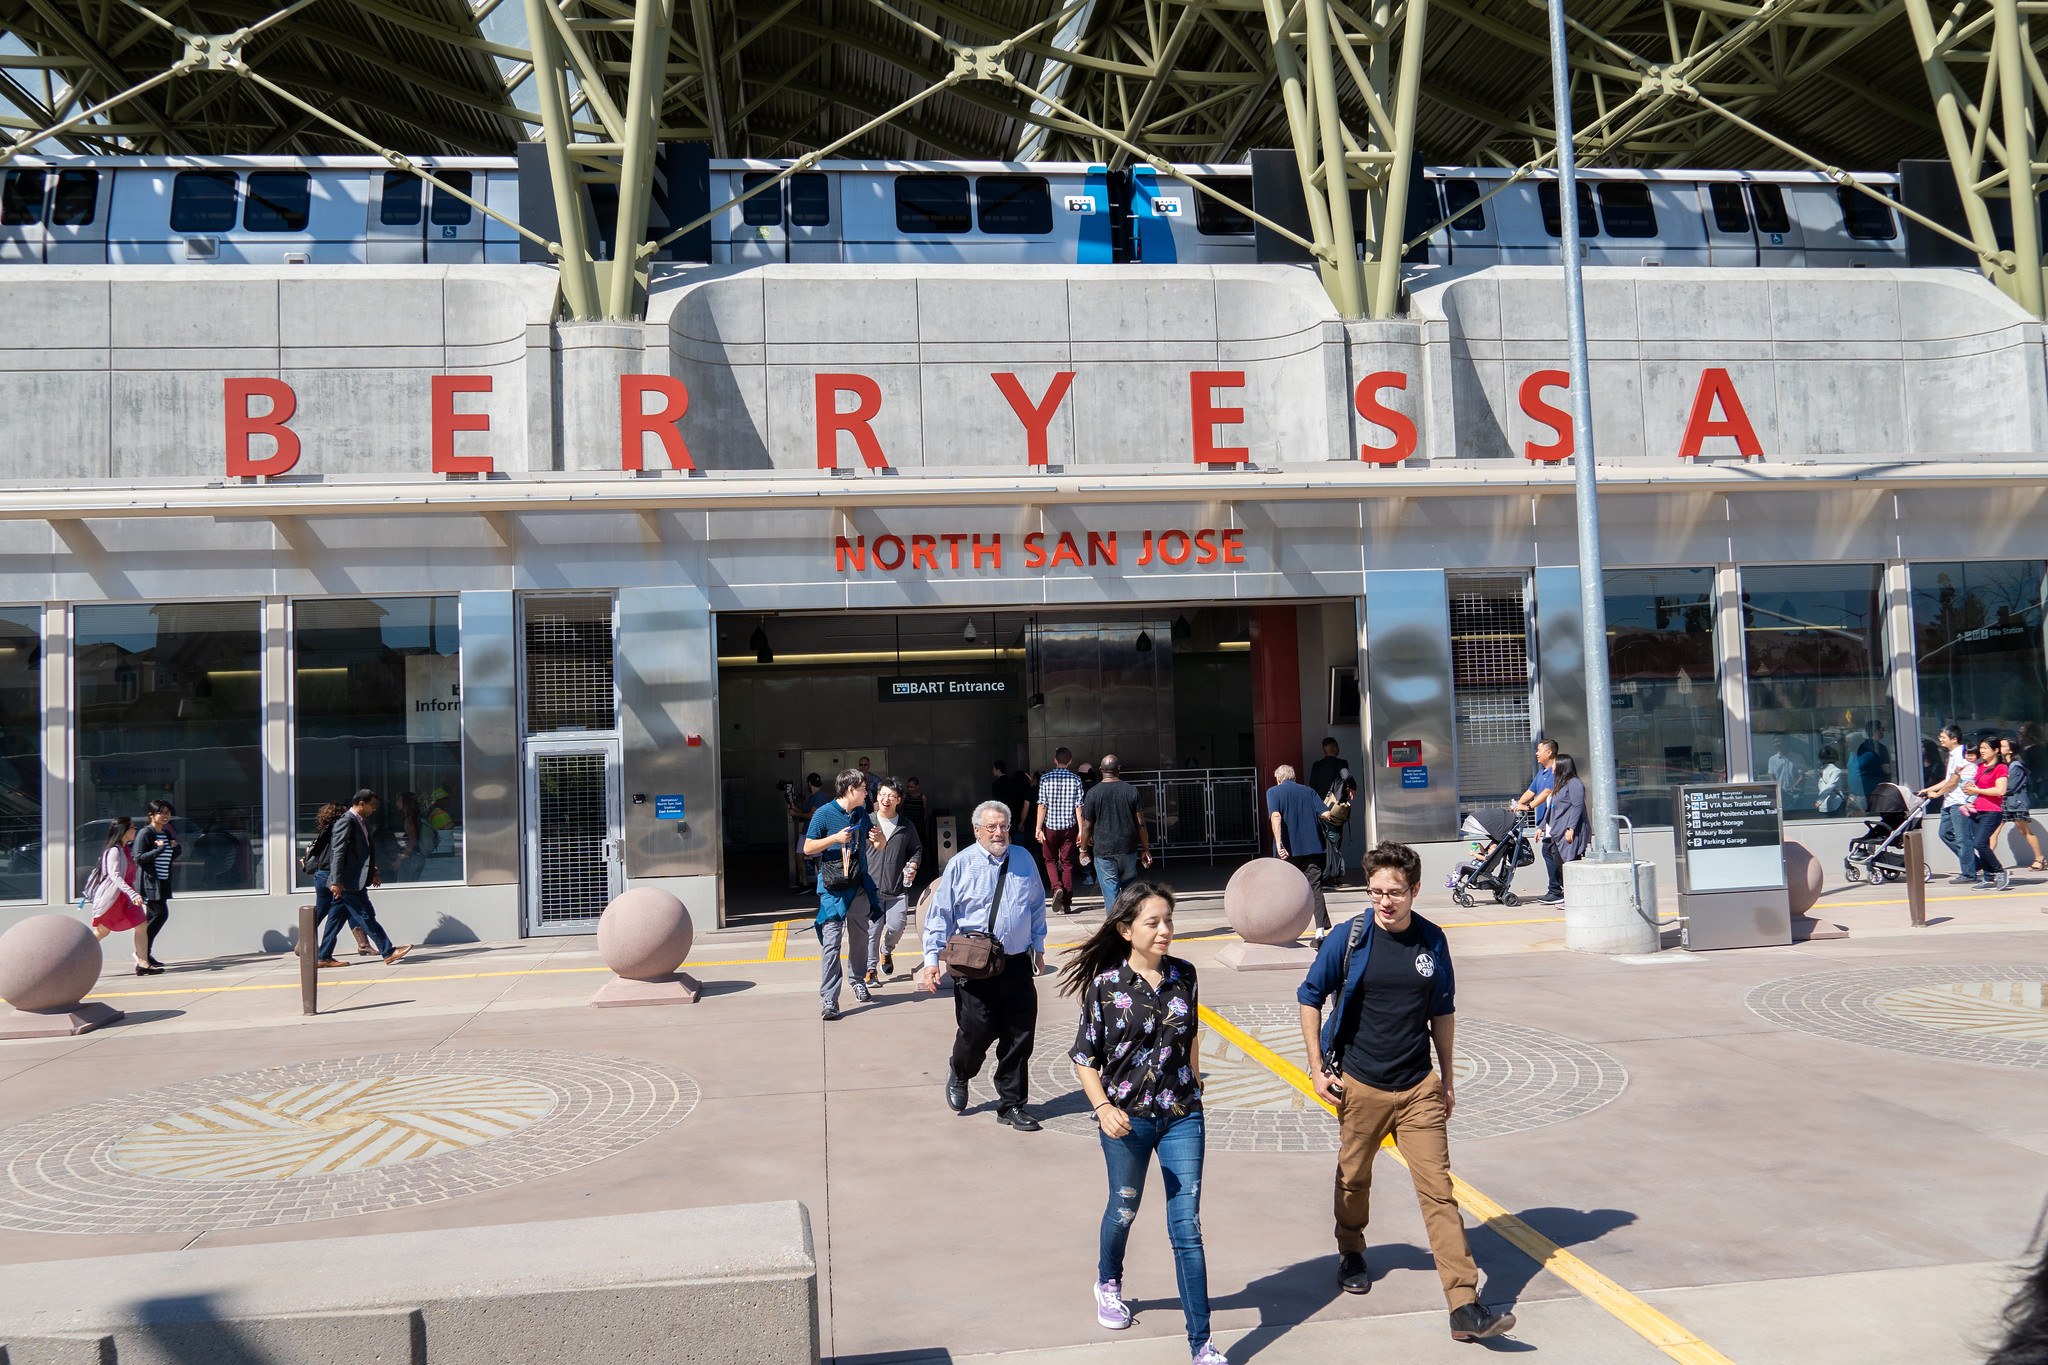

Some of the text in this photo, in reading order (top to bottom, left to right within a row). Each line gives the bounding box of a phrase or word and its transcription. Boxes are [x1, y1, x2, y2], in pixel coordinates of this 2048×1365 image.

[224, 367, 1764, 478] BERRYESSA
[835, 528, 1246, 571] NORTH SAN JOSE
[1989, 627, 2024, 637] Bike Station
[910, 682, 945, 694] BART
[949, 681, 1005, 693] Entrance
